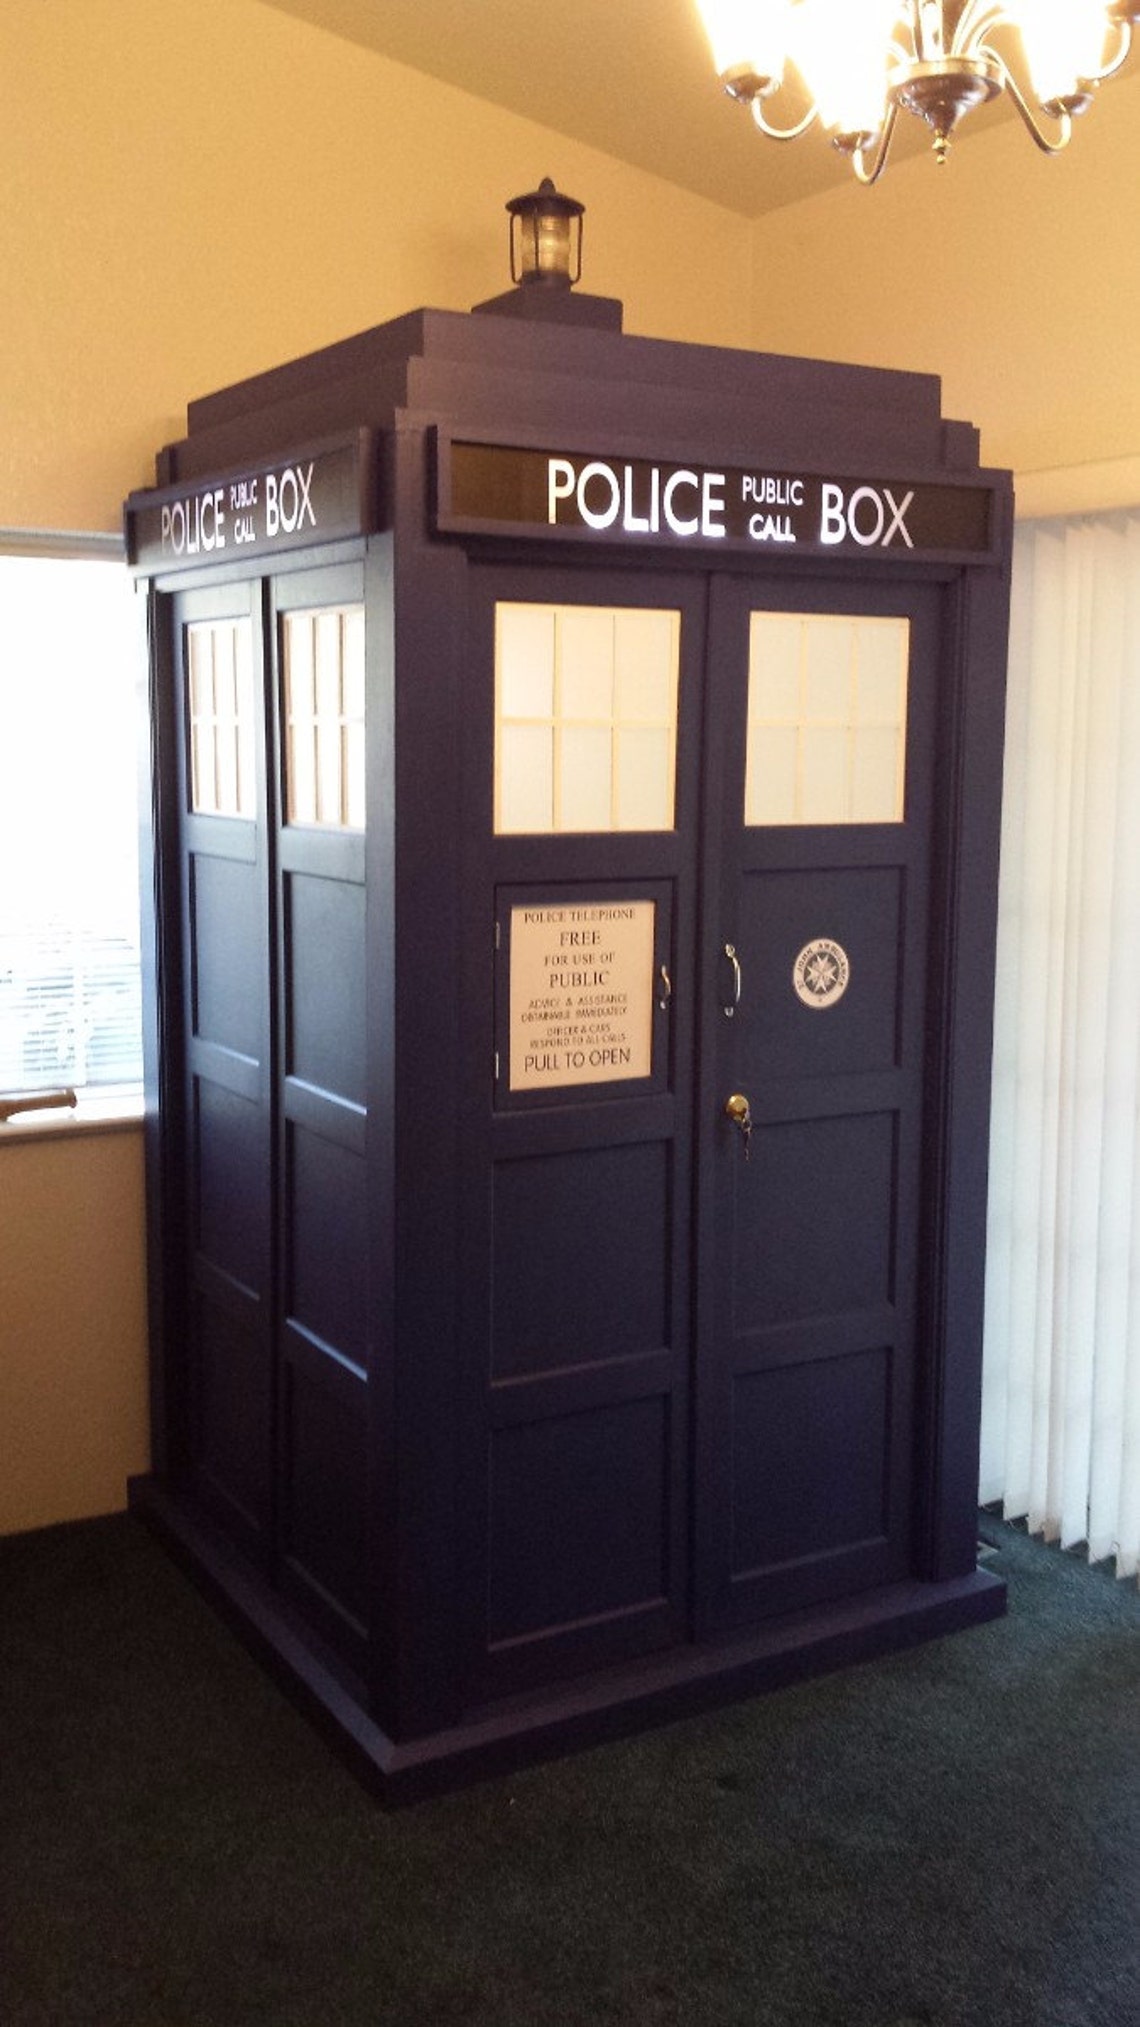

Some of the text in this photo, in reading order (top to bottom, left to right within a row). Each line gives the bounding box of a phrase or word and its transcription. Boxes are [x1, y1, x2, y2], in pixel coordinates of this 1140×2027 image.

[162, 462, 316, 555] POLICE PUBLIC BOX
[548, 459, 914, 548] POLICE PUBLIC BOX
[234, 516, 256, 544] CALL
[748, 513, 796, 543] CALL
[524, 908, 636, 924] POLICE TELEPHONE
[560, 931, 601, 946] FREE
[544, 952, 615, 967] FOR USE OF
[550, 970, 610, 988] PUBLIC
[525, 1047, 631, 1073] PULL TO OPEN
